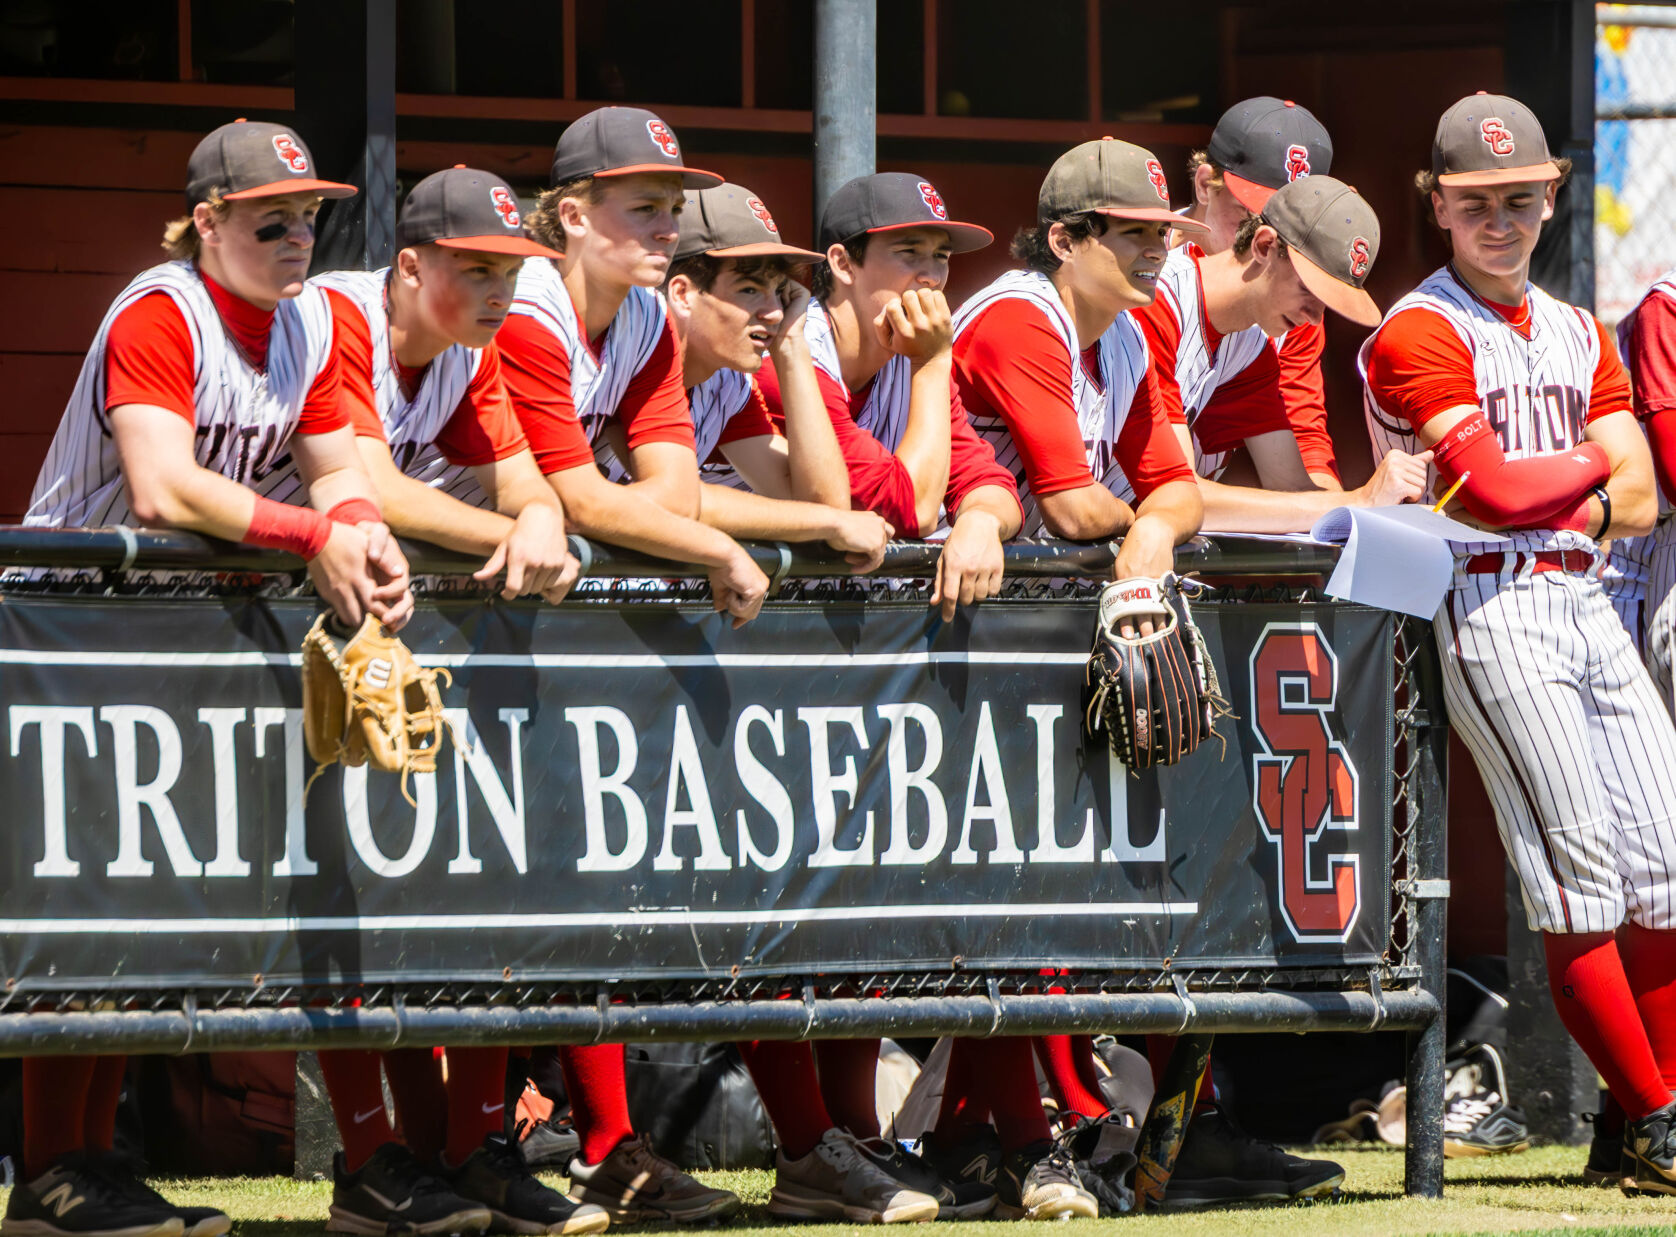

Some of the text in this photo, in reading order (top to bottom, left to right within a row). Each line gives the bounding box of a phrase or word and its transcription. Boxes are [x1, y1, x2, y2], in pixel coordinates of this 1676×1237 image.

[1480, 117, 1514, 157] SC
[1457, 420, 1483, 442] BOLT
[9, 701, 1167, 878] TRITON BASEBALL
[1249, 622, 1360, 943] SC
